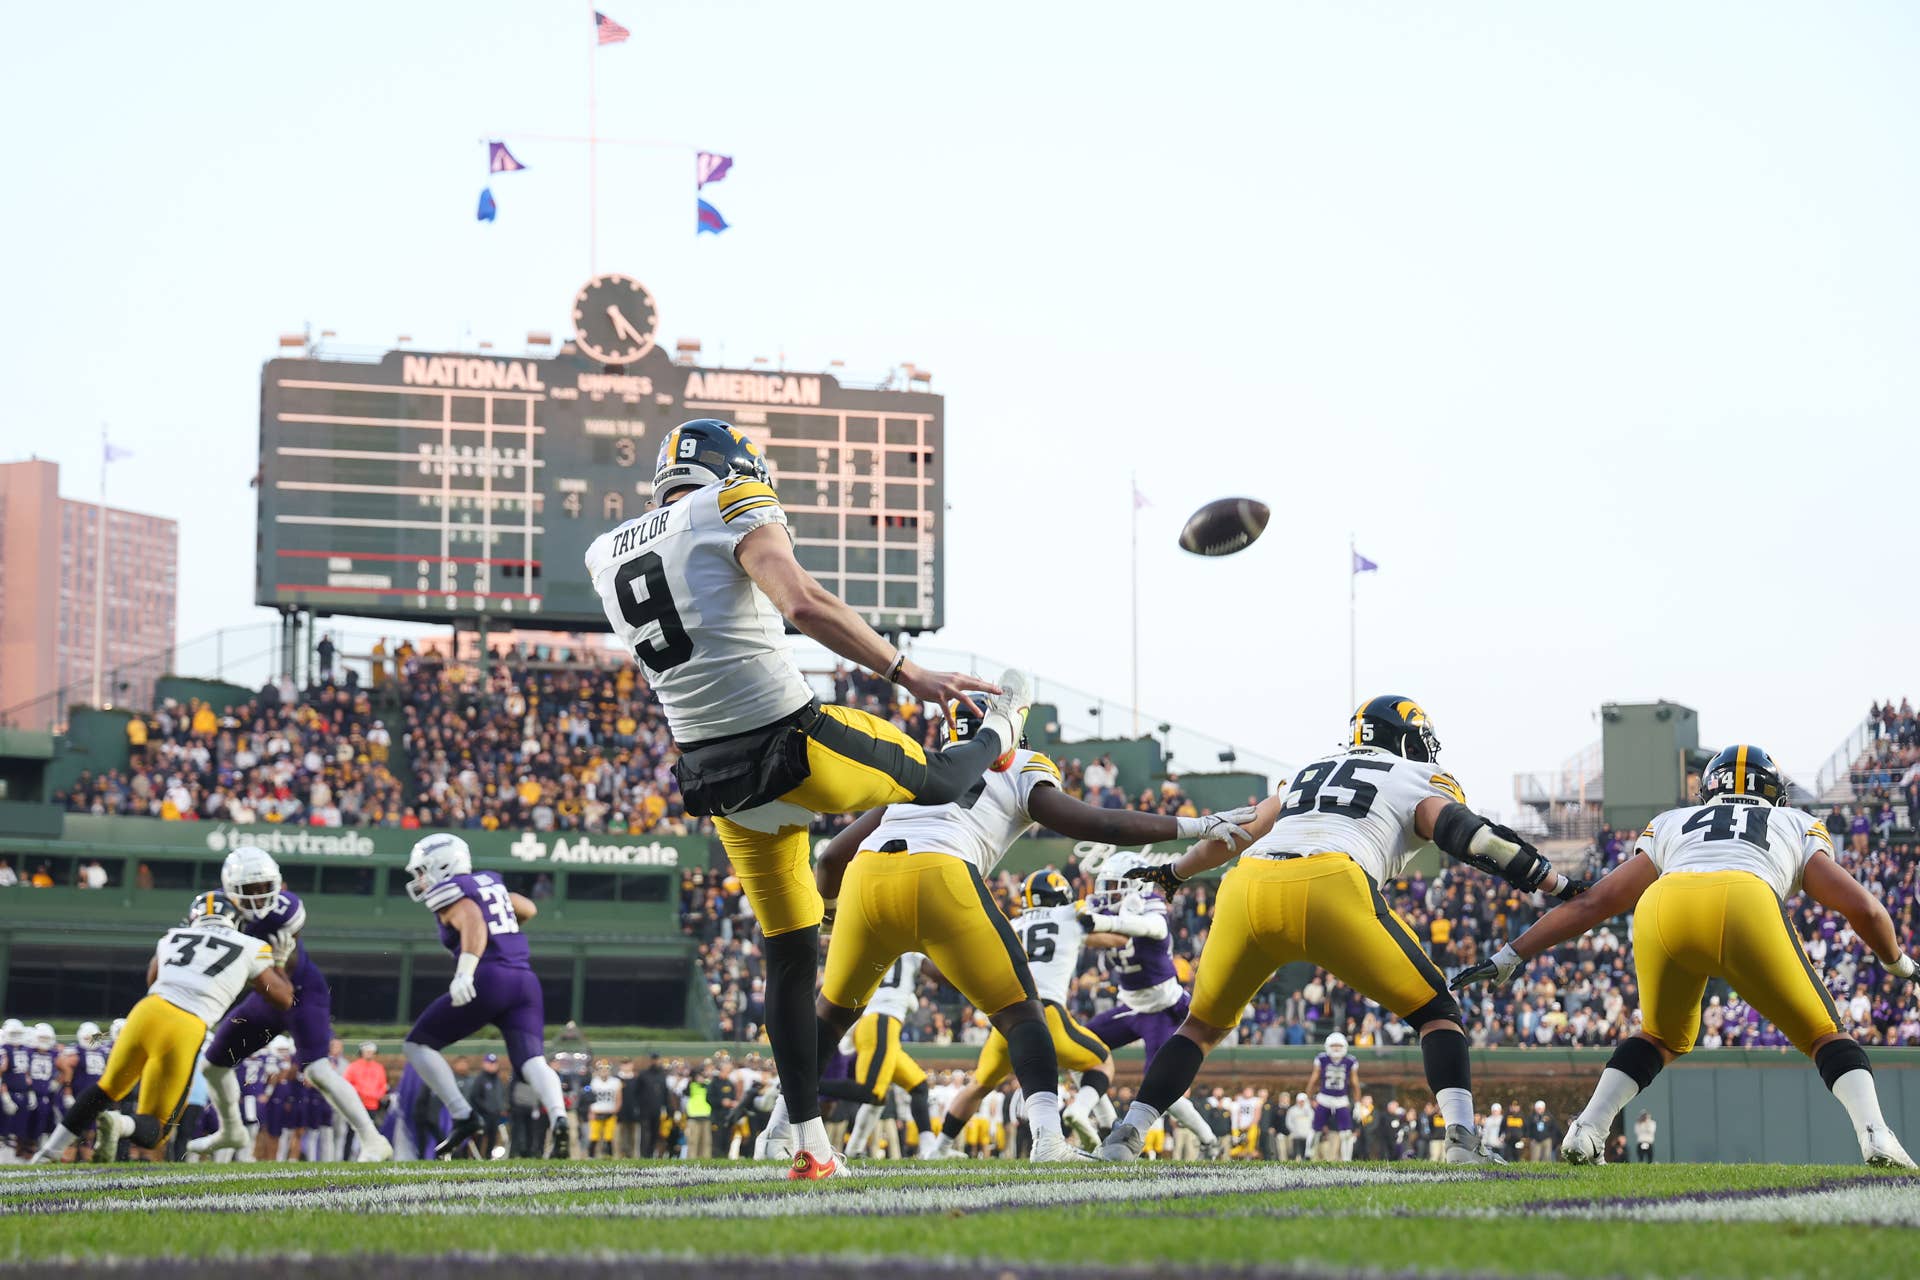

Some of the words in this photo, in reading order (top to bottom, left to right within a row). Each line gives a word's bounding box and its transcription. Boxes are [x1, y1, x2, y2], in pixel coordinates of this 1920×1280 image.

[402, 355, 545, 392] NATIONAL
[684, 371, 821, 406] AMERICAN
[615, 437, 637, 468] 3
[679, 438, 697, 459] 9
[612, 510, 671, 558] TAYLOR
[614, 550, 694, 674] 9
[1276, 759, 1395, 820] 95
[1681, 803, 1772, 852] 41
[550, 836, 678, 867] Advocate
[164, 933, 244, 978] 37
